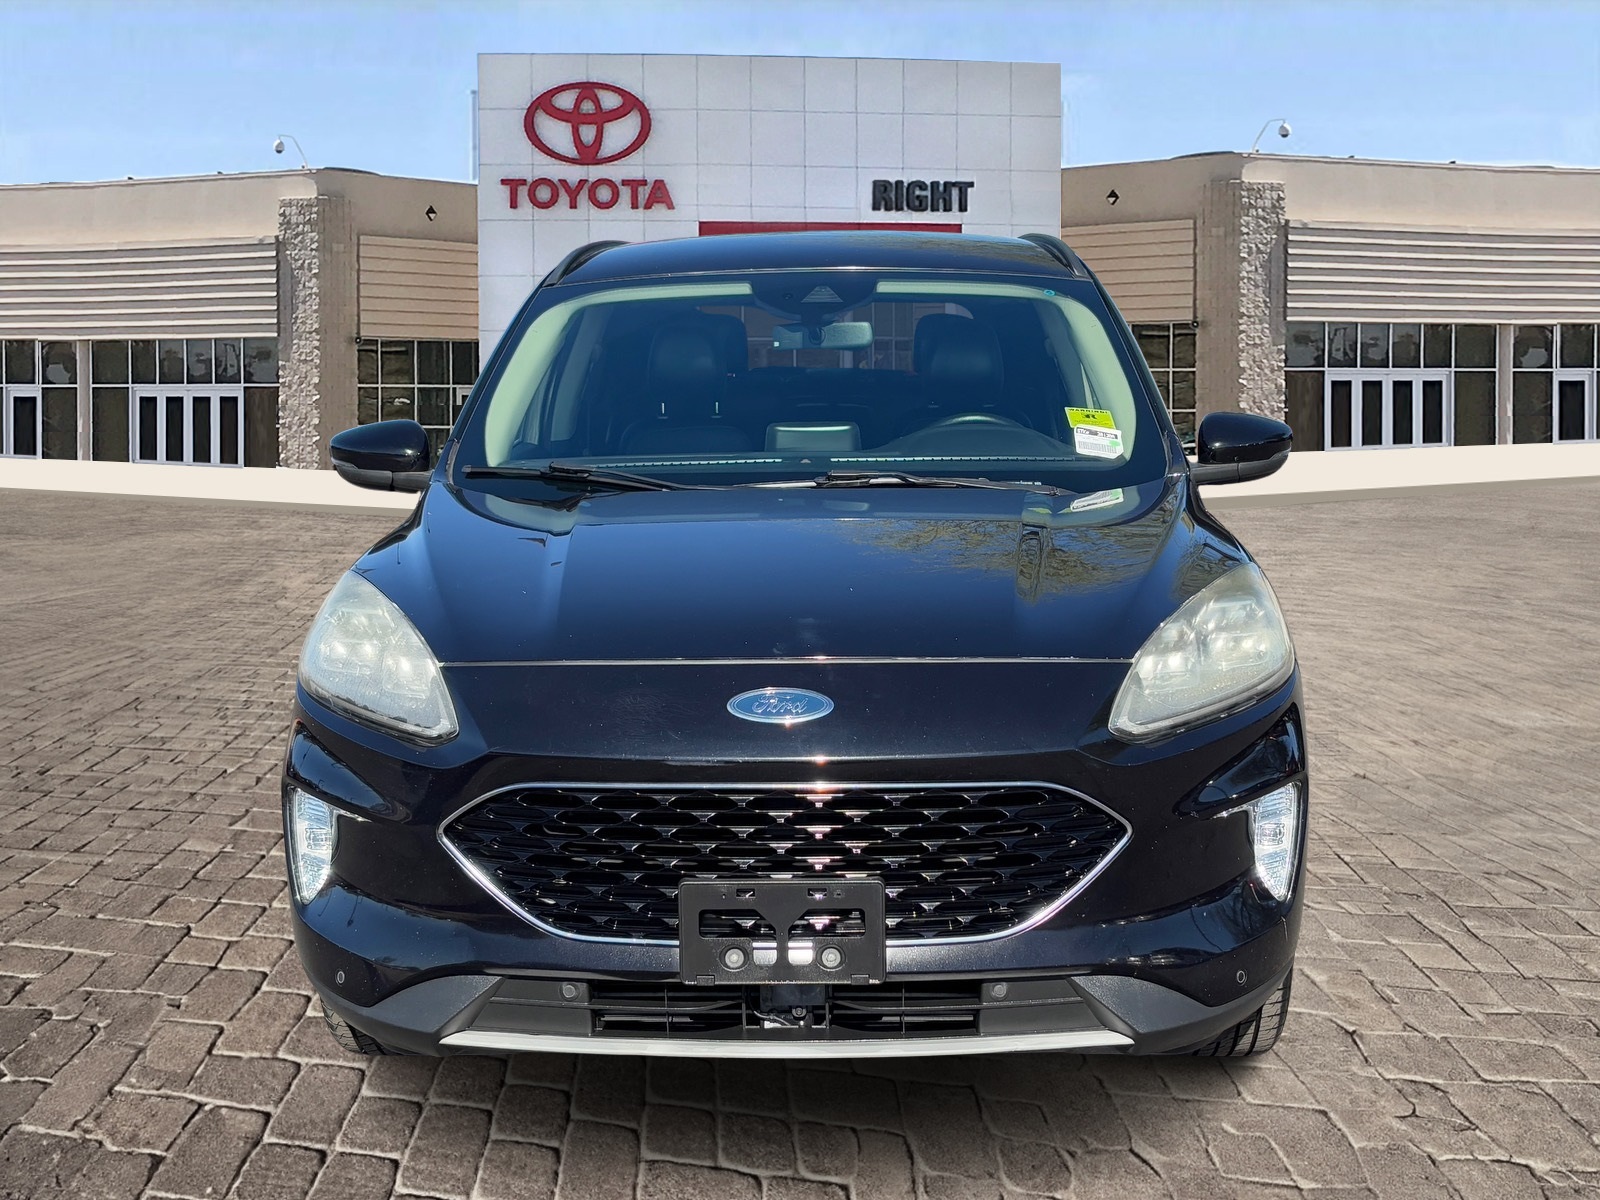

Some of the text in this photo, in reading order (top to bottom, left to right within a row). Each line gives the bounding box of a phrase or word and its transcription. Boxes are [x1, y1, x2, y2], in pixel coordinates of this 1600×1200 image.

[500, 178, 675, 210] TOYOTA
[872, 180, 975, 212] RIGHT
[751, 694, 809, 713] Ford
